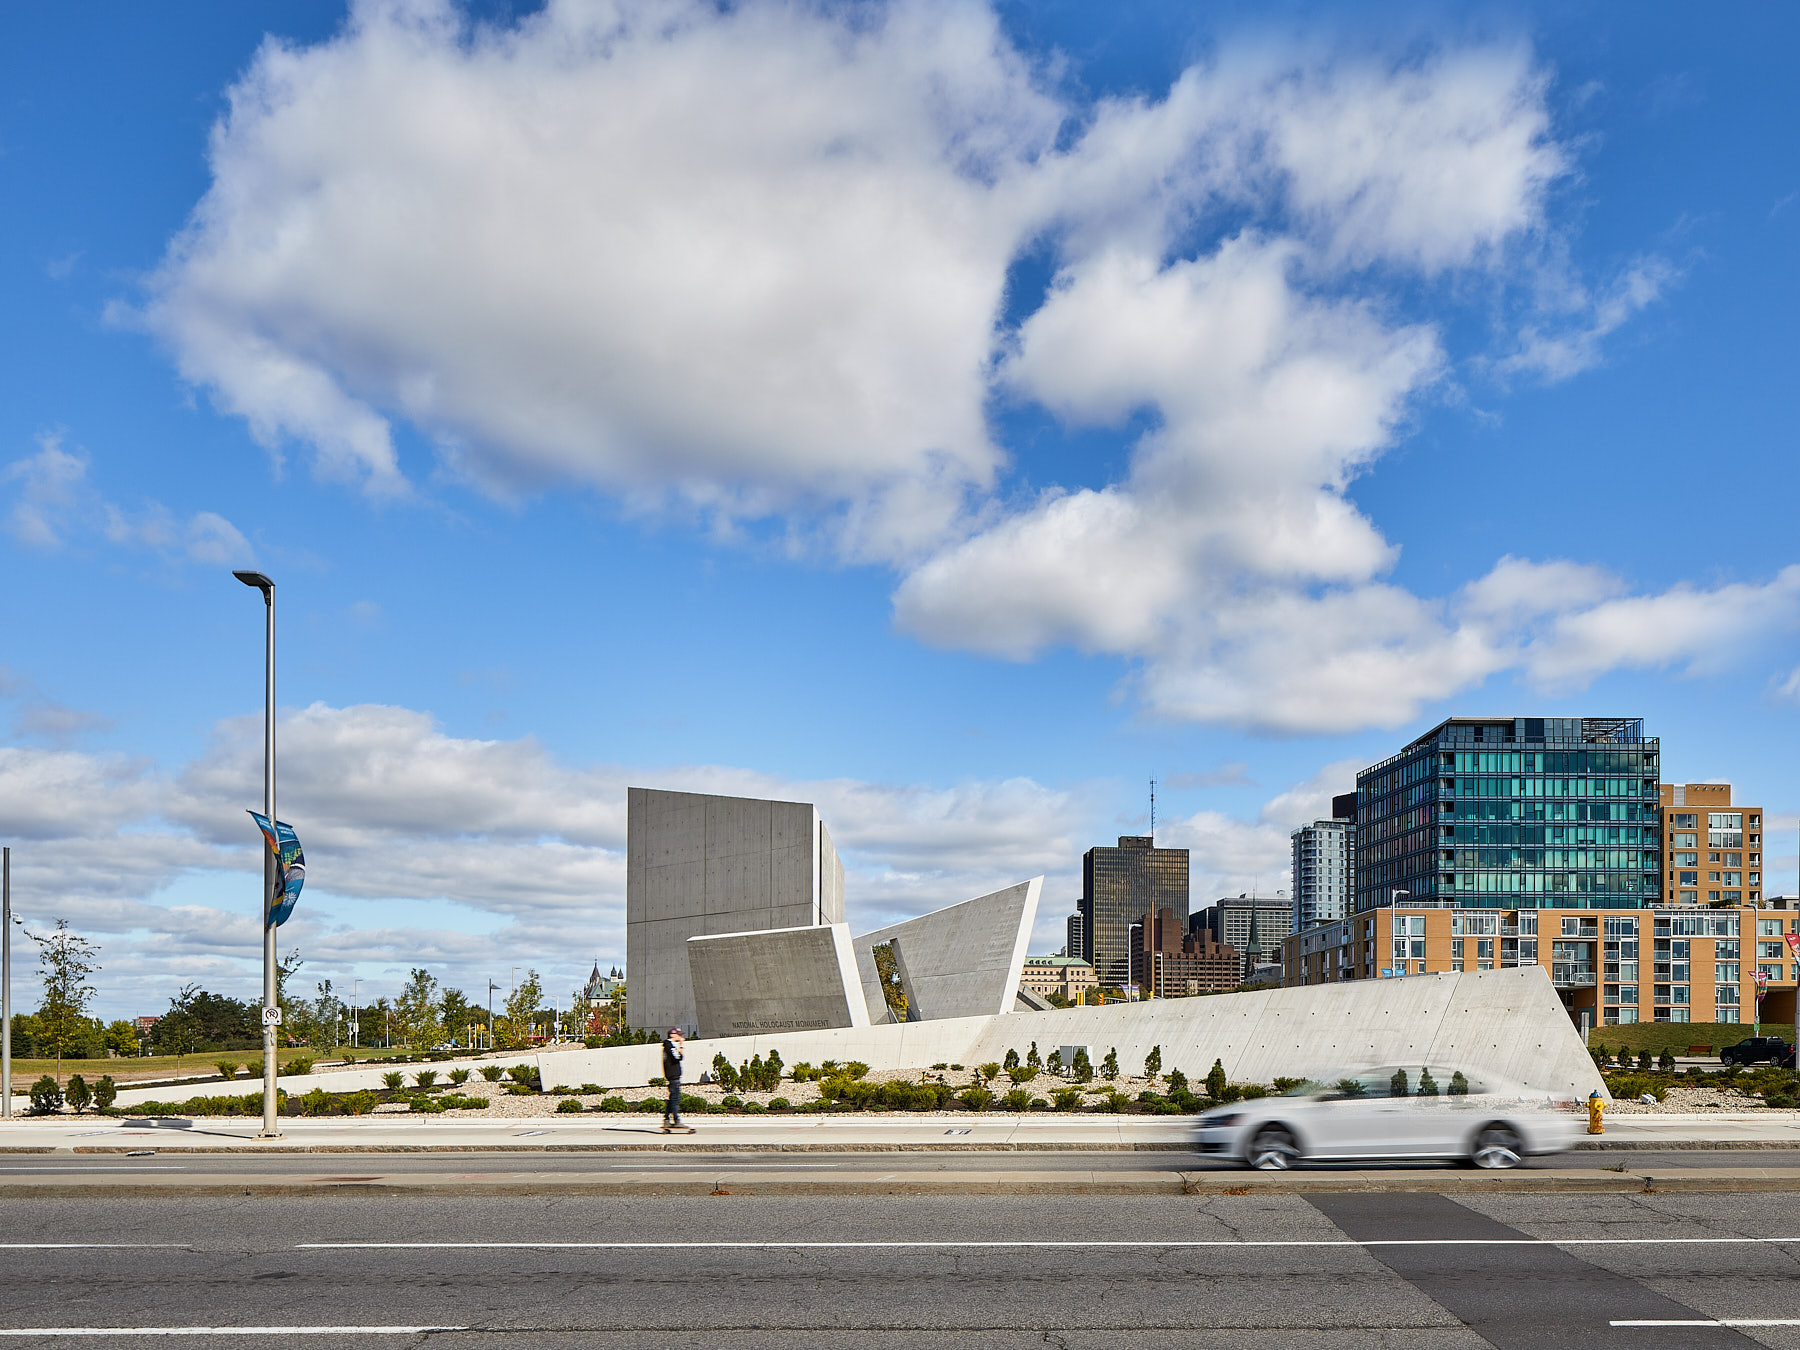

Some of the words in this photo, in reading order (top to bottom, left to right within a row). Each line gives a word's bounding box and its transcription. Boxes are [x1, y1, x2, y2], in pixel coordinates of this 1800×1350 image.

[732, 1021, 759, 1029] NATIONAL
[760, 1020, 794, 1029] HOLOCAUST
[795, 1019, 829, 1028] MONUMENT
